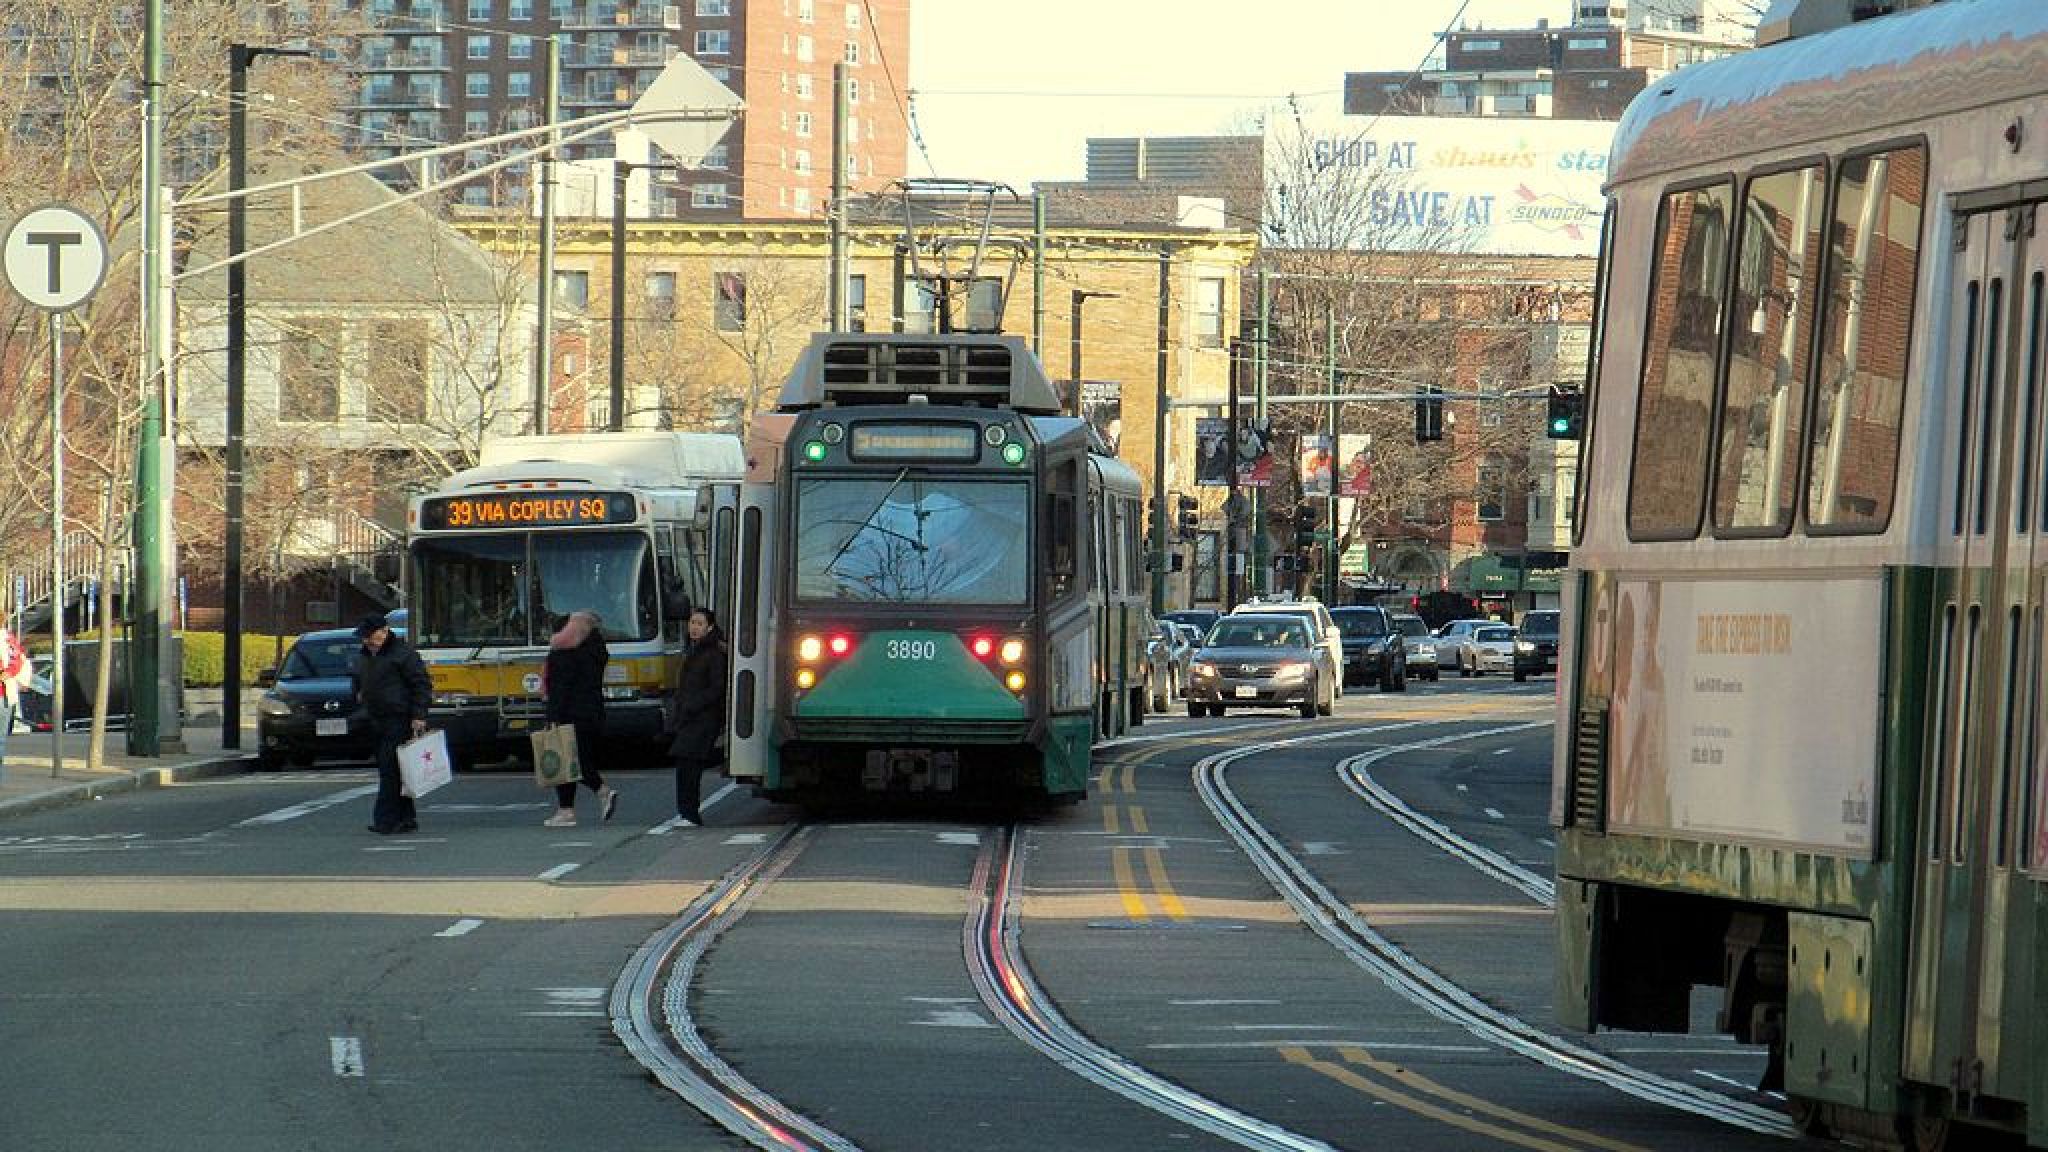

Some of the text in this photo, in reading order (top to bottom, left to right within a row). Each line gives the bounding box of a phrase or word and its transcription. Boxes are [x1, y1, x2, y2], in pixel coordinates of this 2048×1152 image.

[1315, 139, 1377, 169] SHOP
[1387, 141, 1417, 169] AT
[1434, 147, 1536, 169] shaw's
[1371, 191, 1496, 227] SAVE AT
[1515, 206, 1587, 221] SUNOCO
[26, 231, 82, 295] T
[449, 498, 605, 526] 39 VIA COPLEY SQ
[887, 639, 936, 661] 3890
